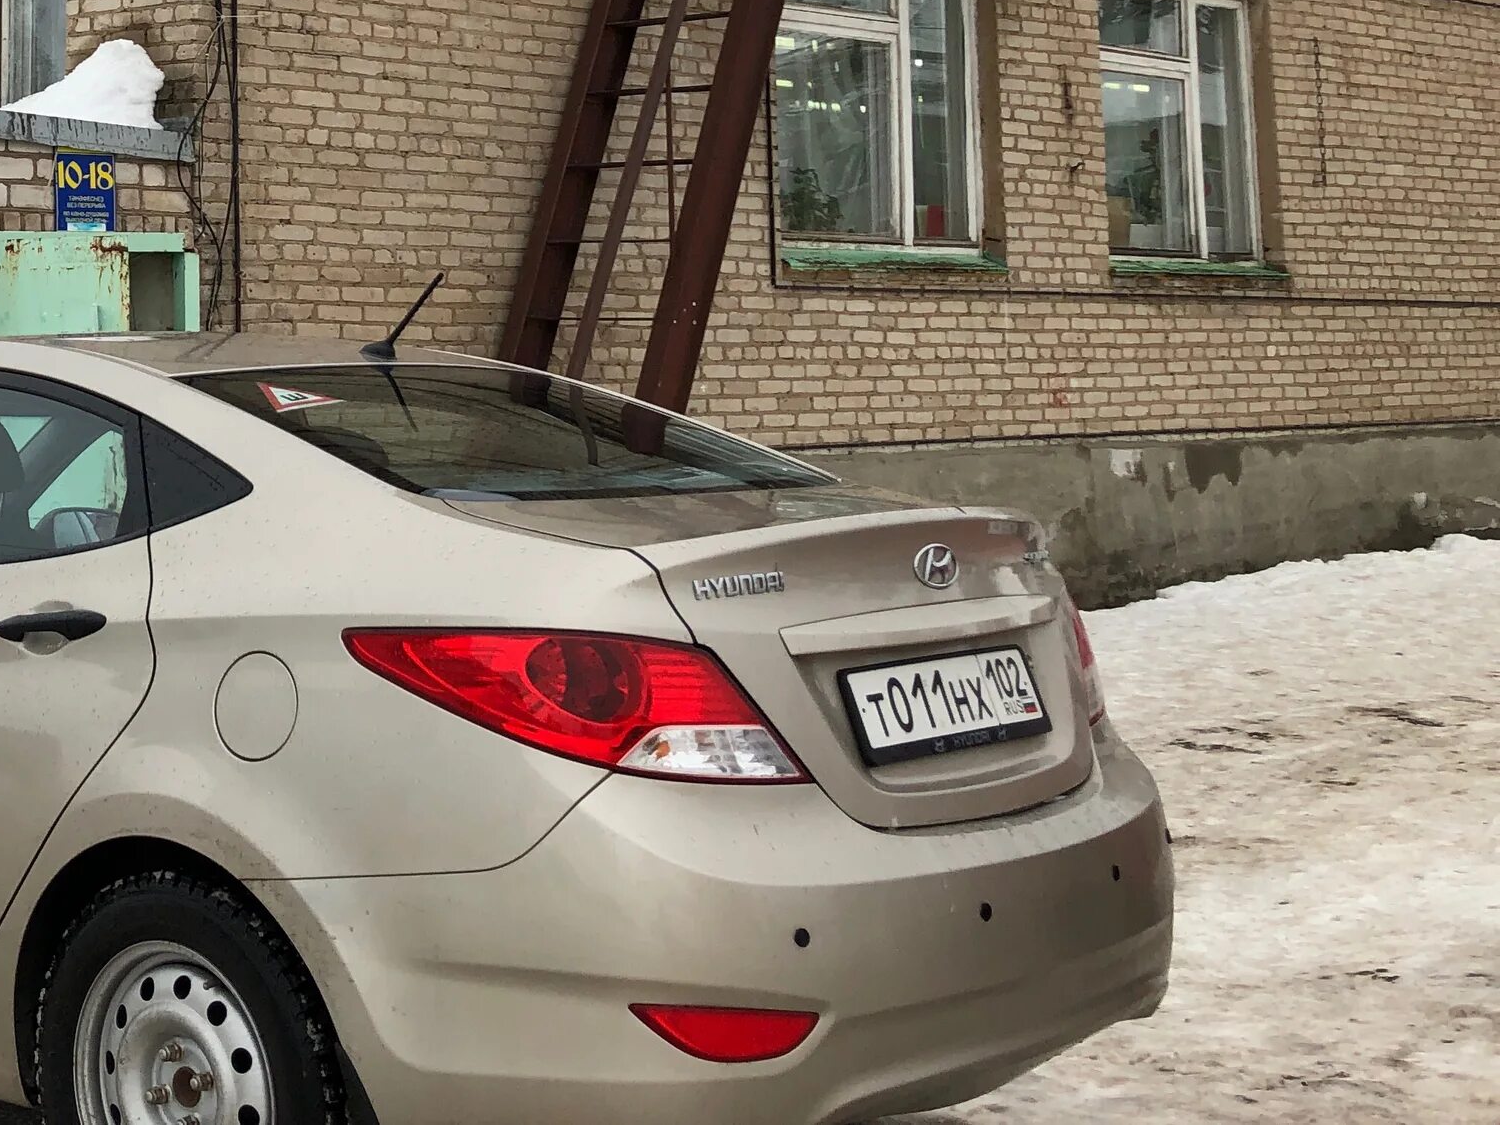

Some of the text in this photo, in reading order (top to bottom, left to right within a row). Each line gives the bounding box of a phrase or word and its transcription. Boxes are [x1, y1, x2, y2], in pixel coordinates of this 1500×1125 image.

[57, 160, 115, 190] 10-18
[692, 571, 785, 601] HYUNDAI
[1003, 700, 1025, 716] RUS
